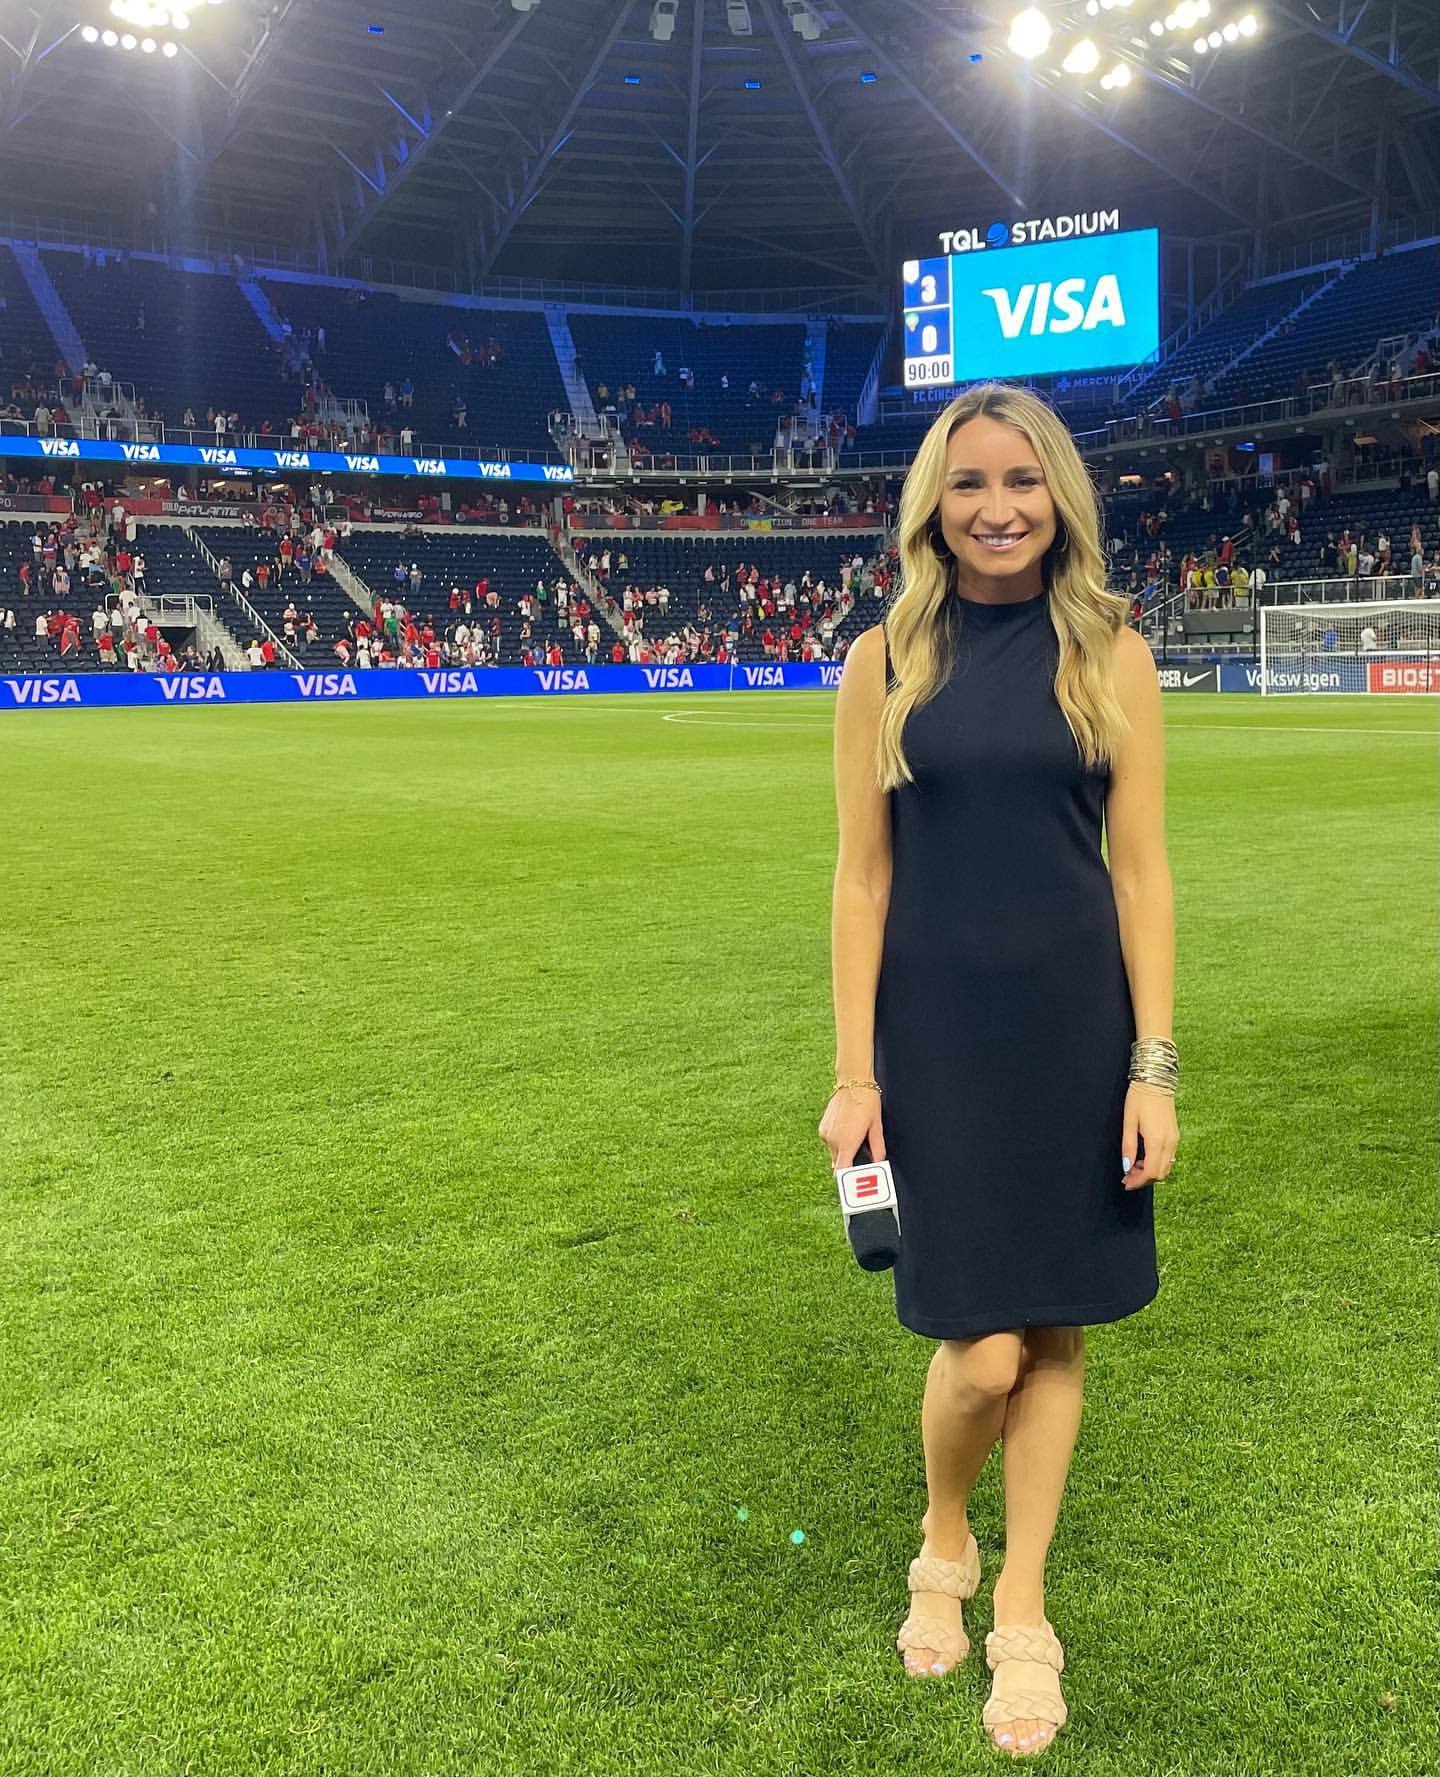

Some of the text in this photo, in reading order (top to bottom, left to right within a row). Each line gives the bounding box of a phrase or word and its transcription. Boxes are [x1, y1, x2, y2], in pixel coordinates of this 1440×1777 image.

[939, 209, 1119, 253] TQL STADIUM
[921, 275, 936, 303] 3
[981, 274, 1126, 338] VISA
[922, 325, 937, 352] 0
[908, 360, 950, 381] 90:00
[39, 440, 80, 457] VISA
[120, 444, 160, 461] VISA
[199, 448, 237, 465] VISA
[274, 452, 310, 469] VISA
[345, 455, 380, 472] VISA
[413, 459, 447, 475] VISA
[479, 463, 511, 479] VISA
[541, 466, 573, 480] VISA
[291, 674, 358, 696] VISA
[417, 672, 479, 693] VISA
[534, 670, 590, 690] VISA
[641, 668, 694, 688] VISA
[743, 666, 785, 686] VISA
[819, 665, 846, 685] VIS
[1157, 670, 1181, 687] CCER
[1246, 669, 1340, 691] Volkswagen
[4, 680, 81, 702] VISA
[154, 677, 226, 699] VISA
